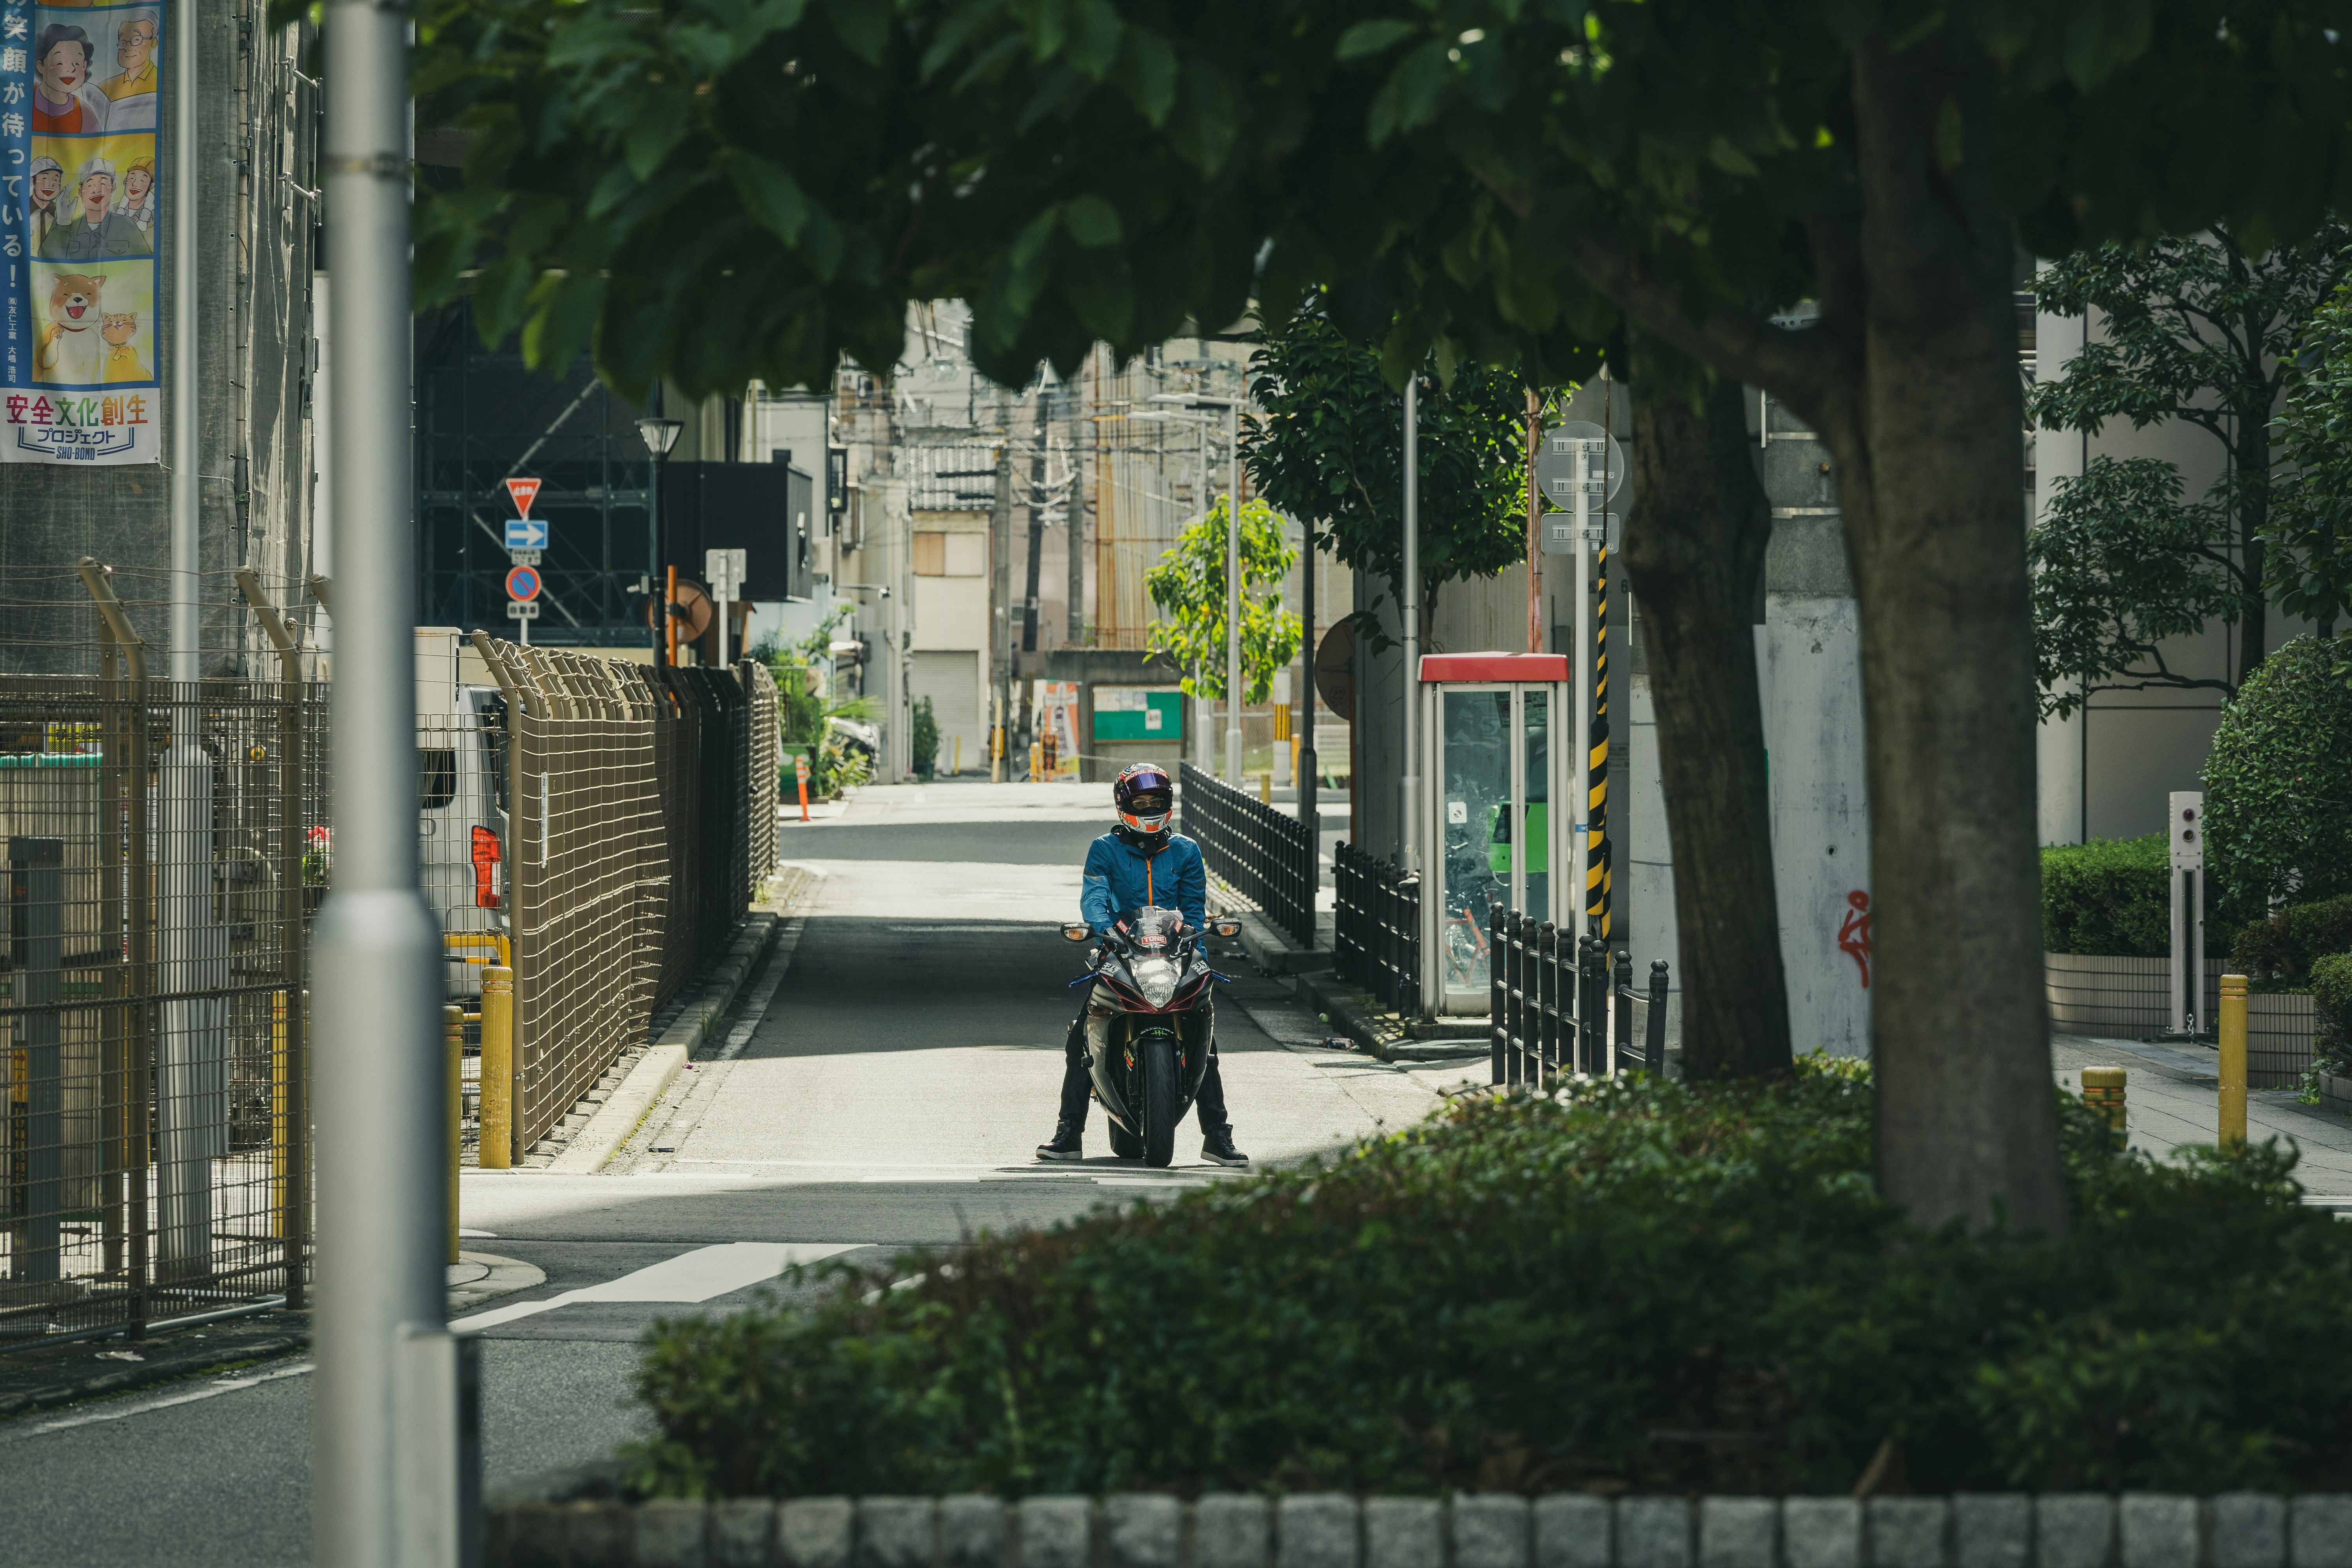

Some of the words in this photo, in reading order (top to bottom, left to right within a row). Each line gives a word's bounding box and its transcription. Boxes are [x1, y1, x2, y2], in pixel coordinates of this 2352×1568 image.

[6, 394, 148, 426] 安全文化創生
[37, 428, 115, 445] プロジェクト
[56, 446, 95, 460] SHO-BOND
[510, 606, 536, 614] 自動車
[1125, 769, 1146, 781] MOTUL
[1148, 768, 1168, 778] MOTUL
[1117, 920, 1127, 933] MOTUL
